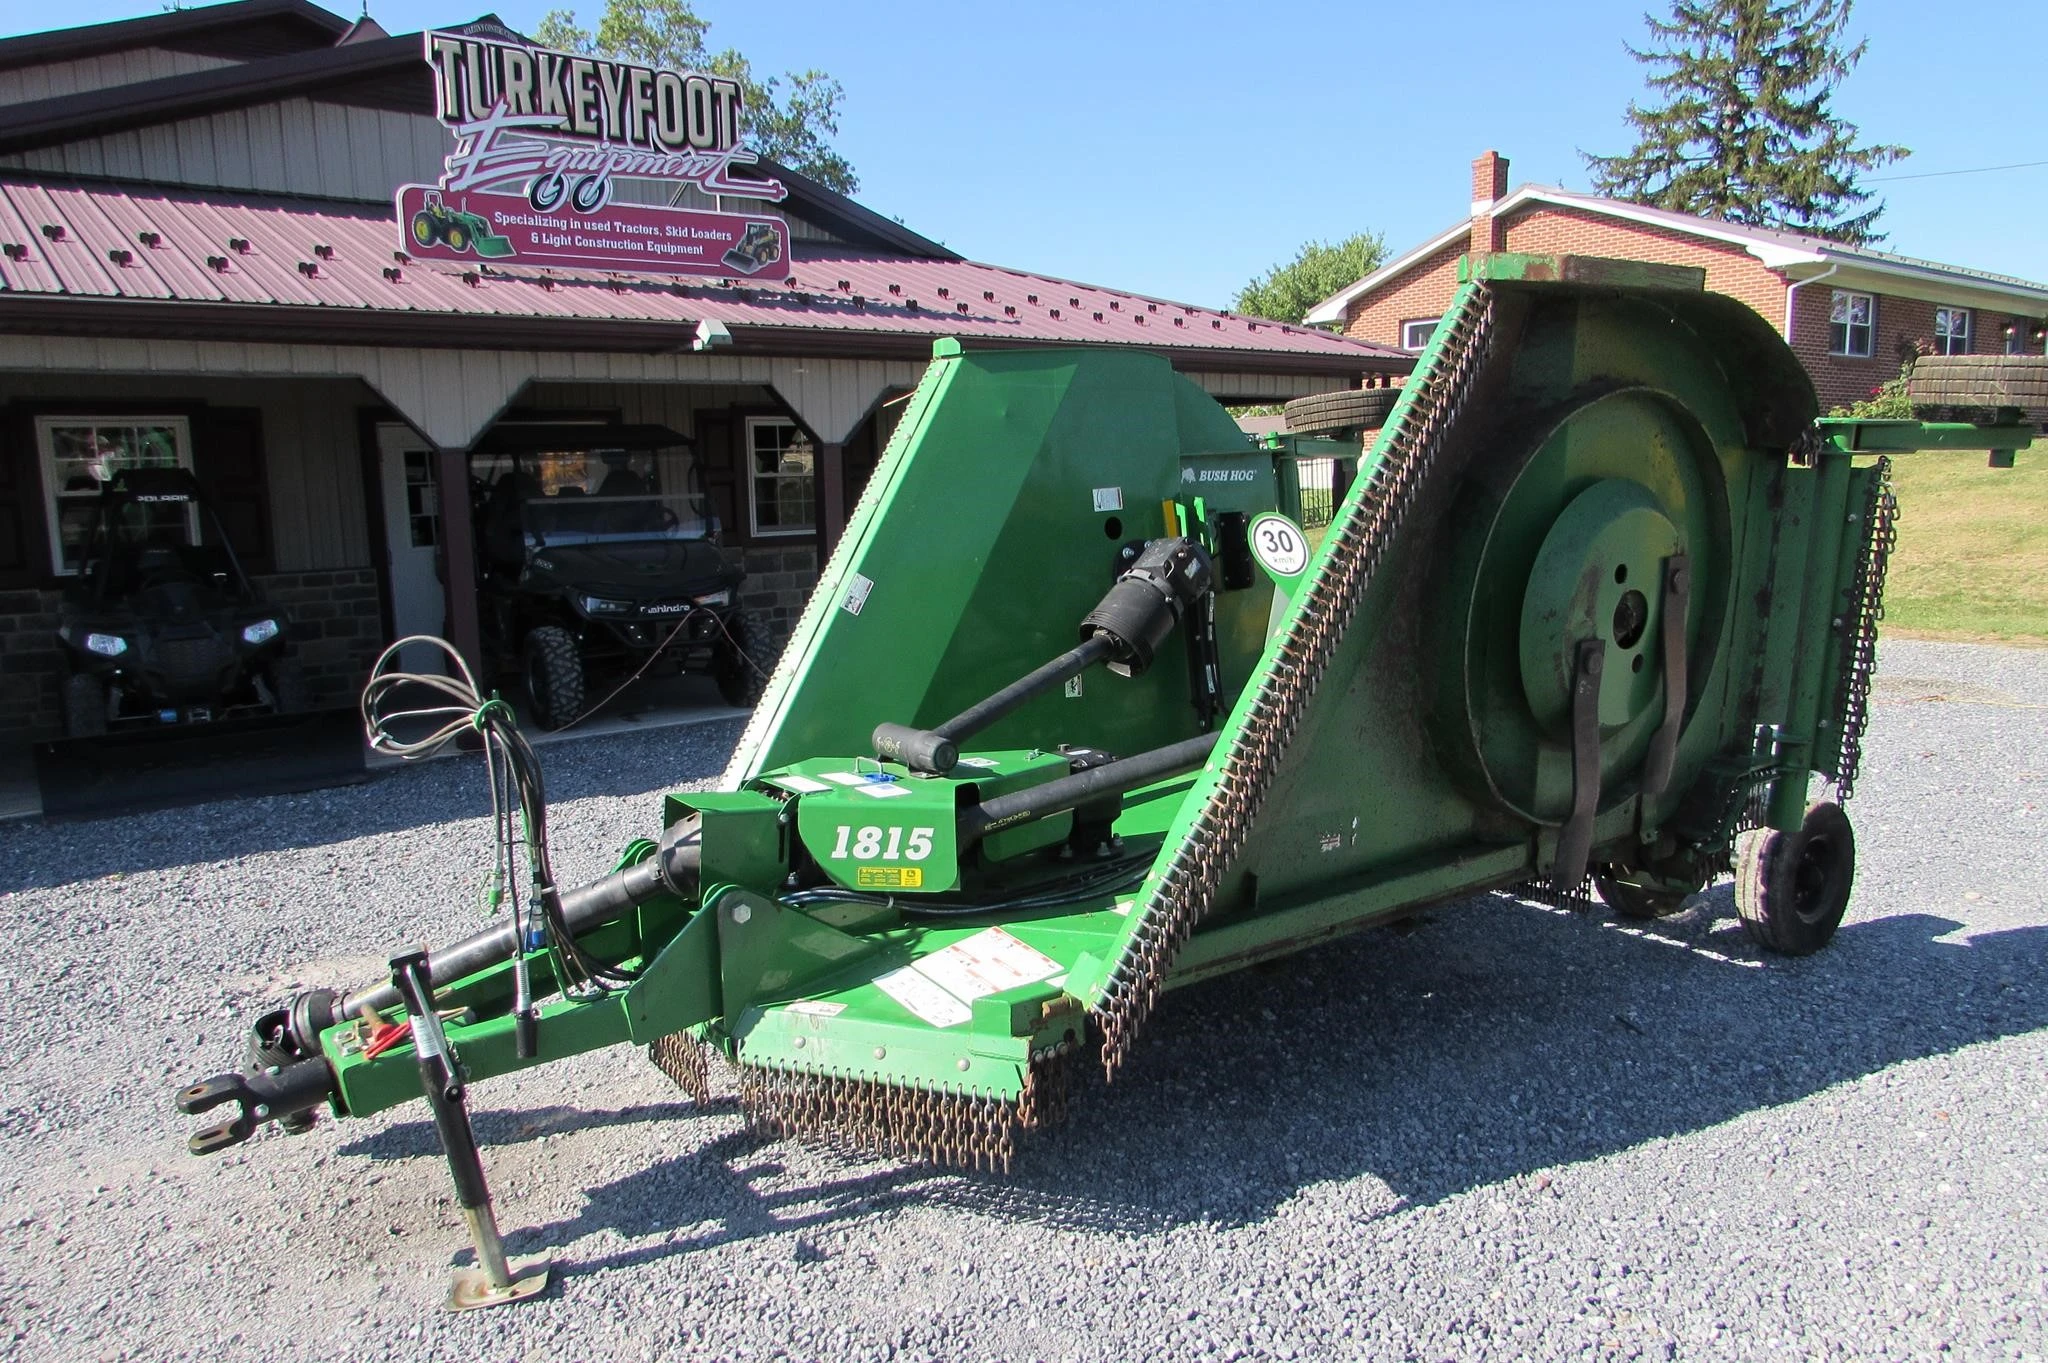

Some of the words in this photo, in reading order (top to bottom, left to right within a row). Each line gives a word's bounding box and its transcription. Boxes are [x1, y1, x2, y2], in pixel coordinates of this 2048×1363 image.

[434, 37, 736, 150] TURKEYFOOT
[450, 98, 787, 203] Equipment
[494, 211, 568, 231] Specializing
[570, 218, 581, 229] in
[584, 220, 611, 232] used
[613, 221, 663, 237] Tractors,
[665, 225, 689, 238] Skid
[691, 227, 732, 241] Loaders
[530, 231, 539, 244] &
[542, 233, 571, 248] Light
[575, 235, 644, 251] Construction
[646, 240, 704, 255] Equipment
[1199, 470, 1229, 482] BUSH
[1230, 470, 1254, 481] HOG
[1262, 530, 1293, 553] 30
[831, 826, 934, 861] 1815
